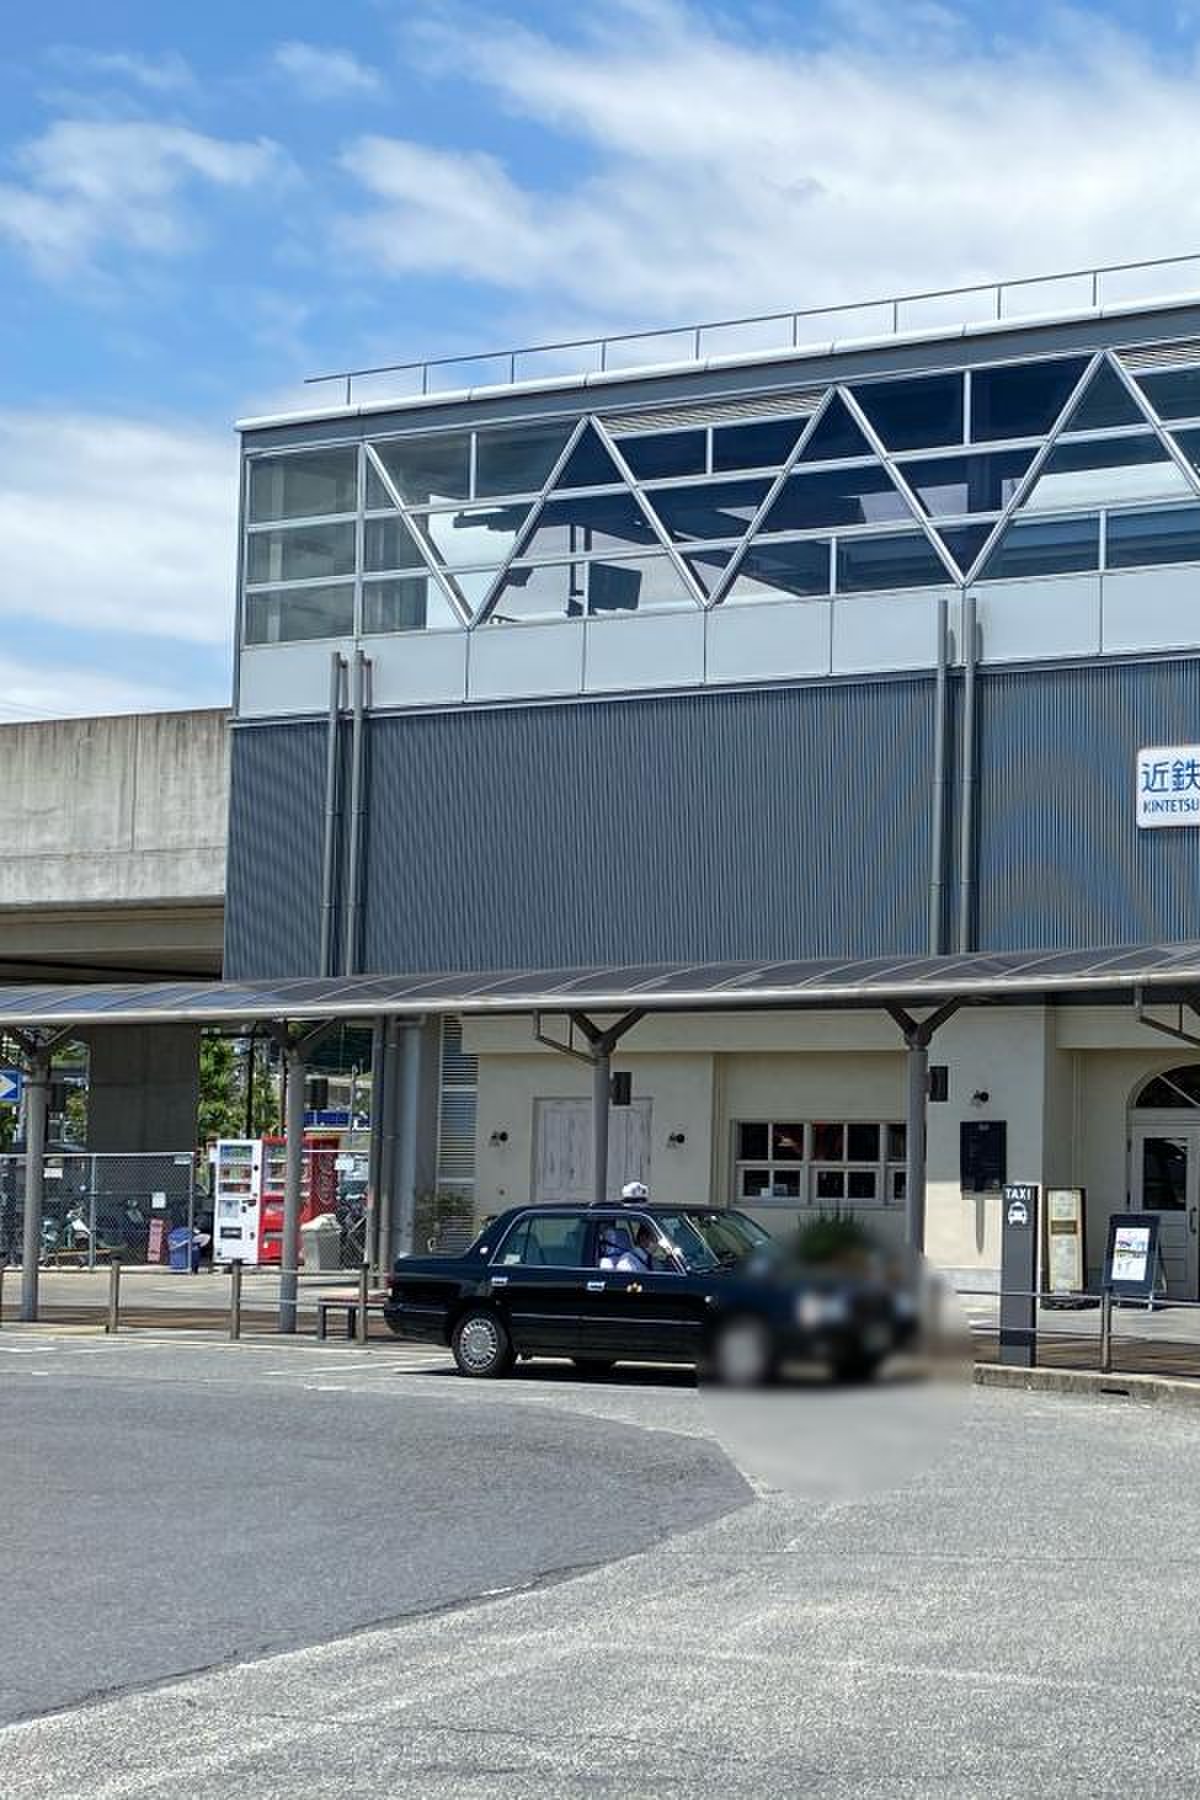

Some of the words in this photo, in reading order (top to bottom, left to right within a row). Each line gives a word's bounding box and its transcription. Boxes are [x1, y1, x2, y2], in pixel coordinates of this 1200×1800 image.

[1141, 759, 1200, 793] 近鉄
[1142, 798, 1200, 814] KINTETSU
[1005, 1188, 1031, 1201] TAXI
